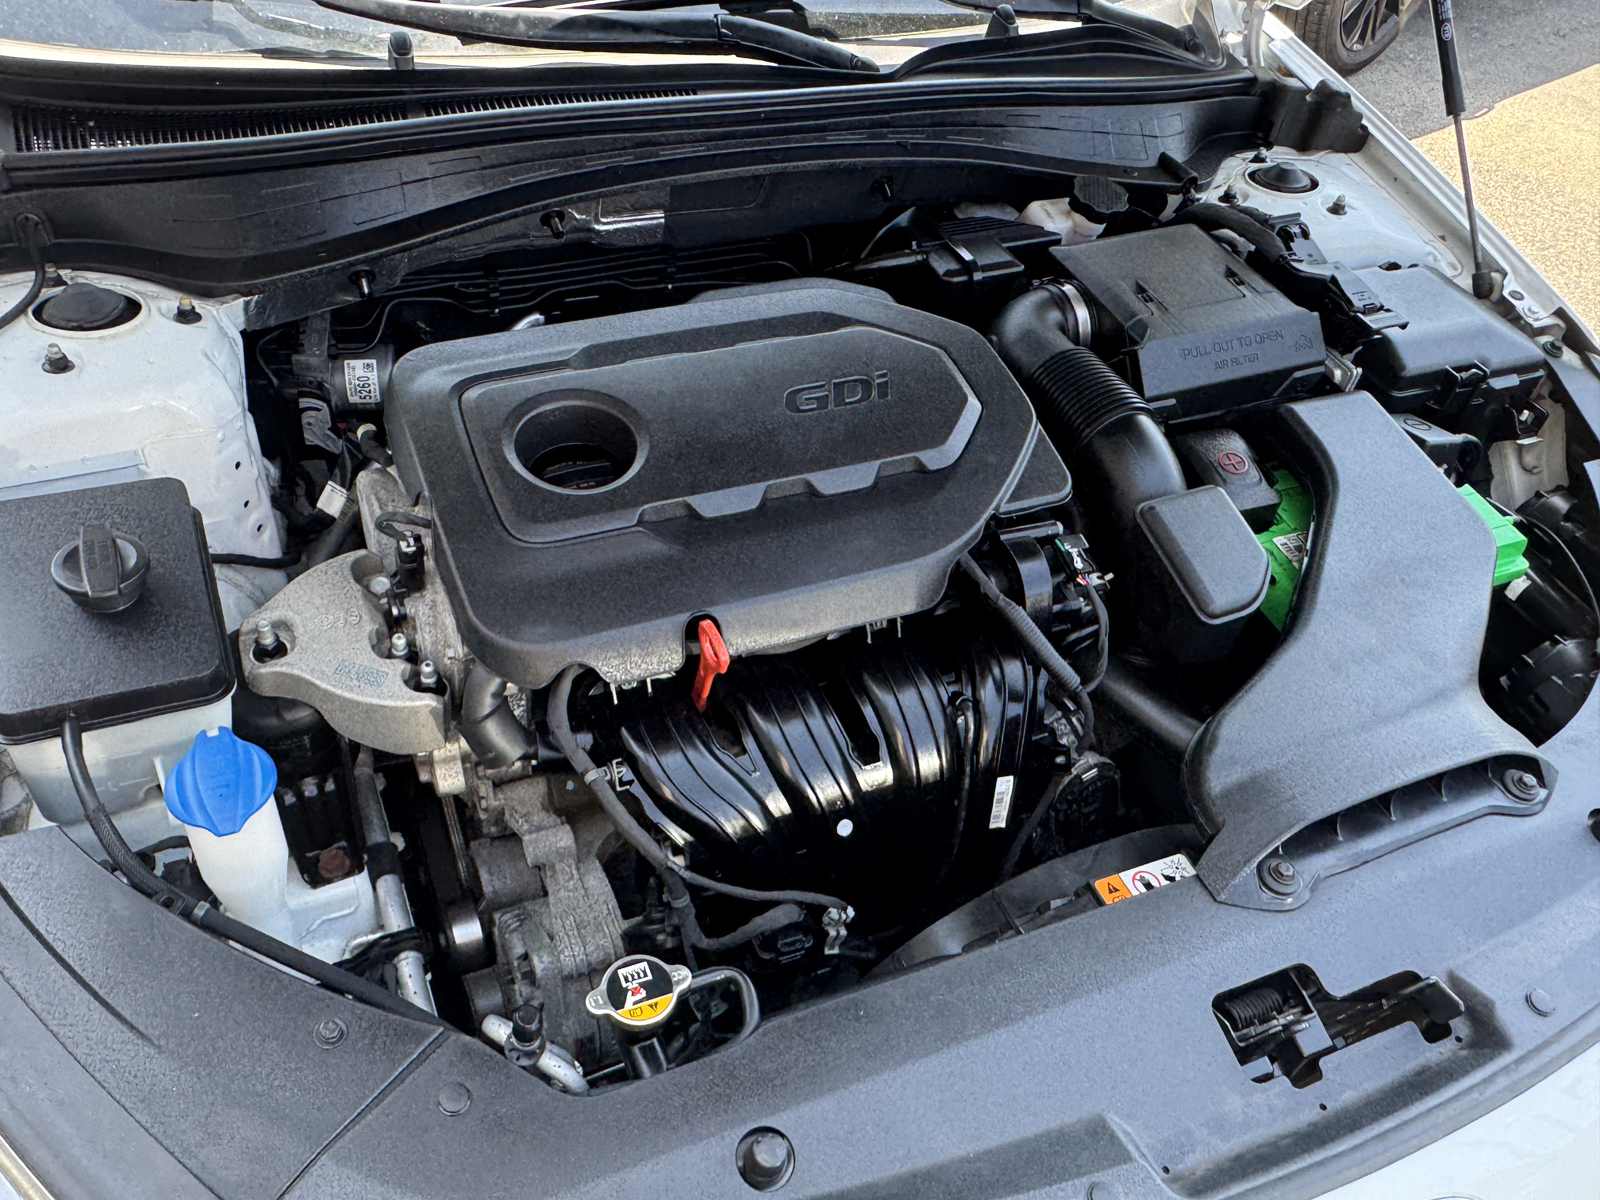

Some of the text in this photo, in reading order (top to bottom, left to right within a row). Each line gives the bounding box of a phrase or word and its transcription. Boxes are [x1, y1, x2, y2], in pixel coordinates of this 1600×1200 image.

[1182, 330, 1284, 360] PULL OUT TO OPEN
[1214, 353, 1260, 371] AIR FILTER
[357, 376, 372, 400] 5260
[784, 370, 890, 415] GDi
